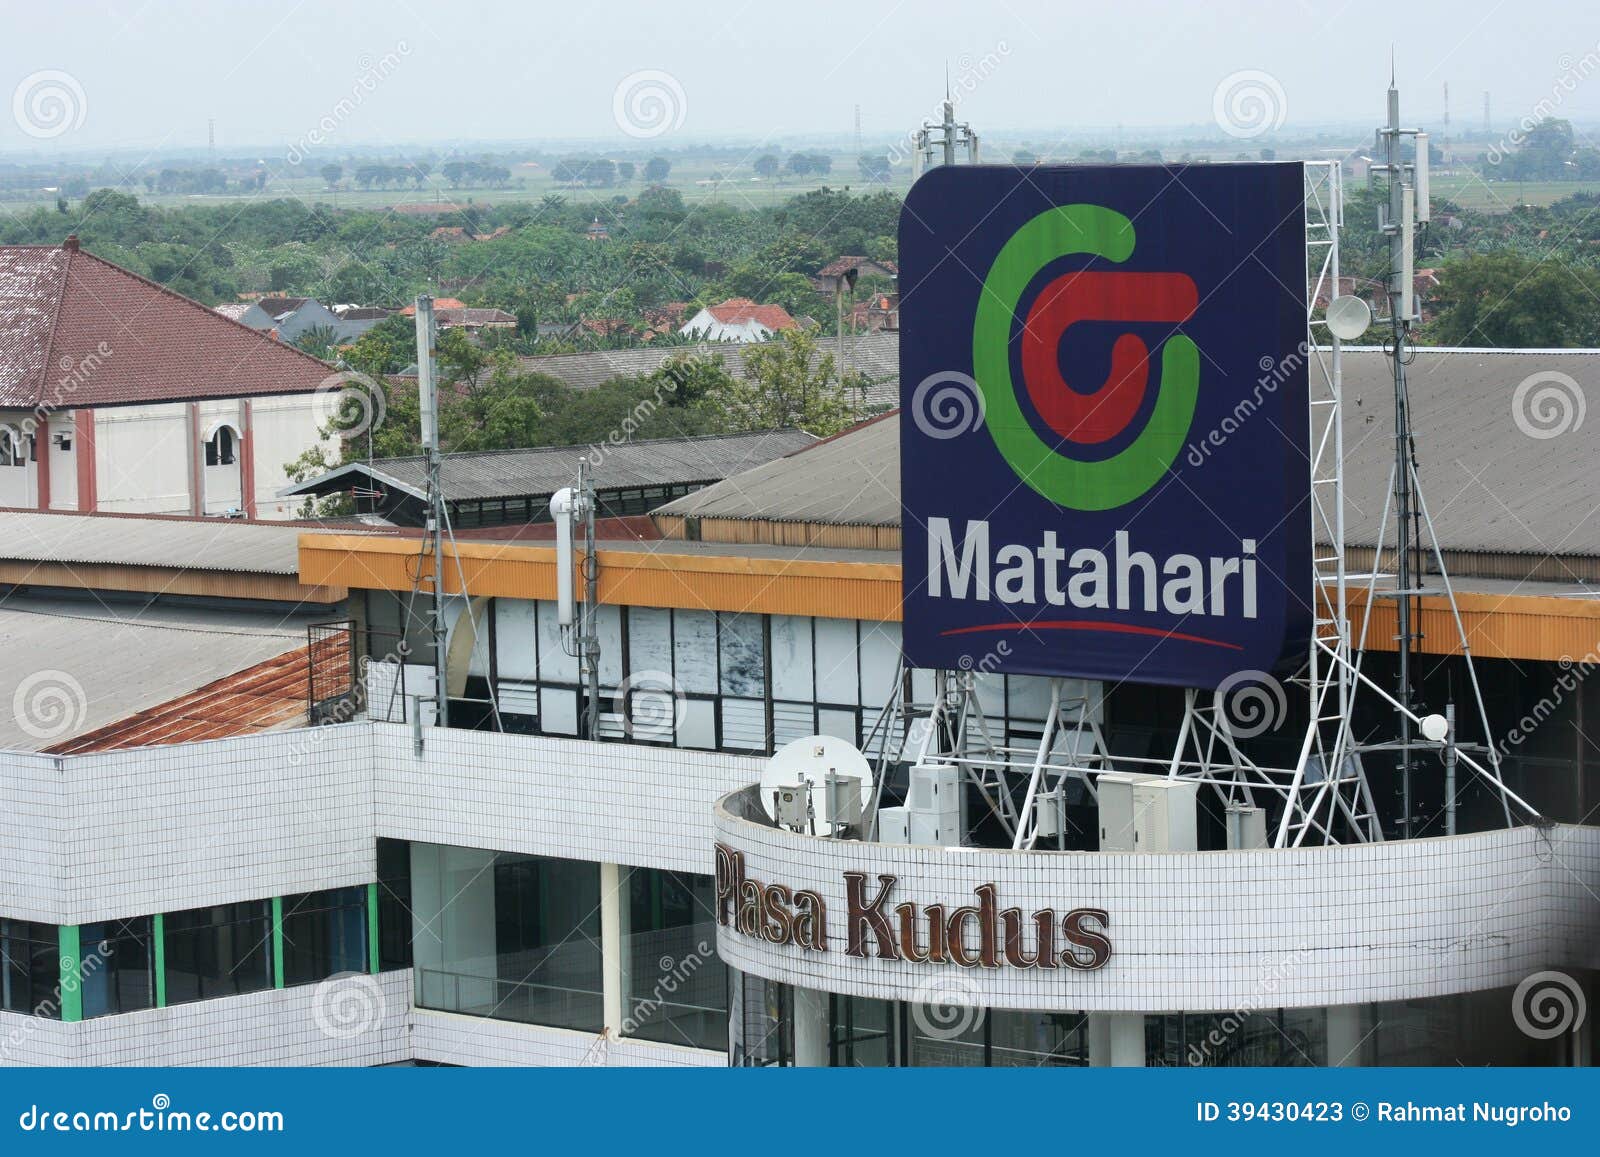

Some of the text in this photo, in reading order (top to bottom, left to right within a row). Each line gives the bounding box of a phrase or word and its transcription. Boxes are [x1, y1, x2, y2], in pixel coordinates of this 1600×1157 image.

[927, 516, 1257, 619] Matahari
[714, 842, 1112, 971] Plasa Kudus
